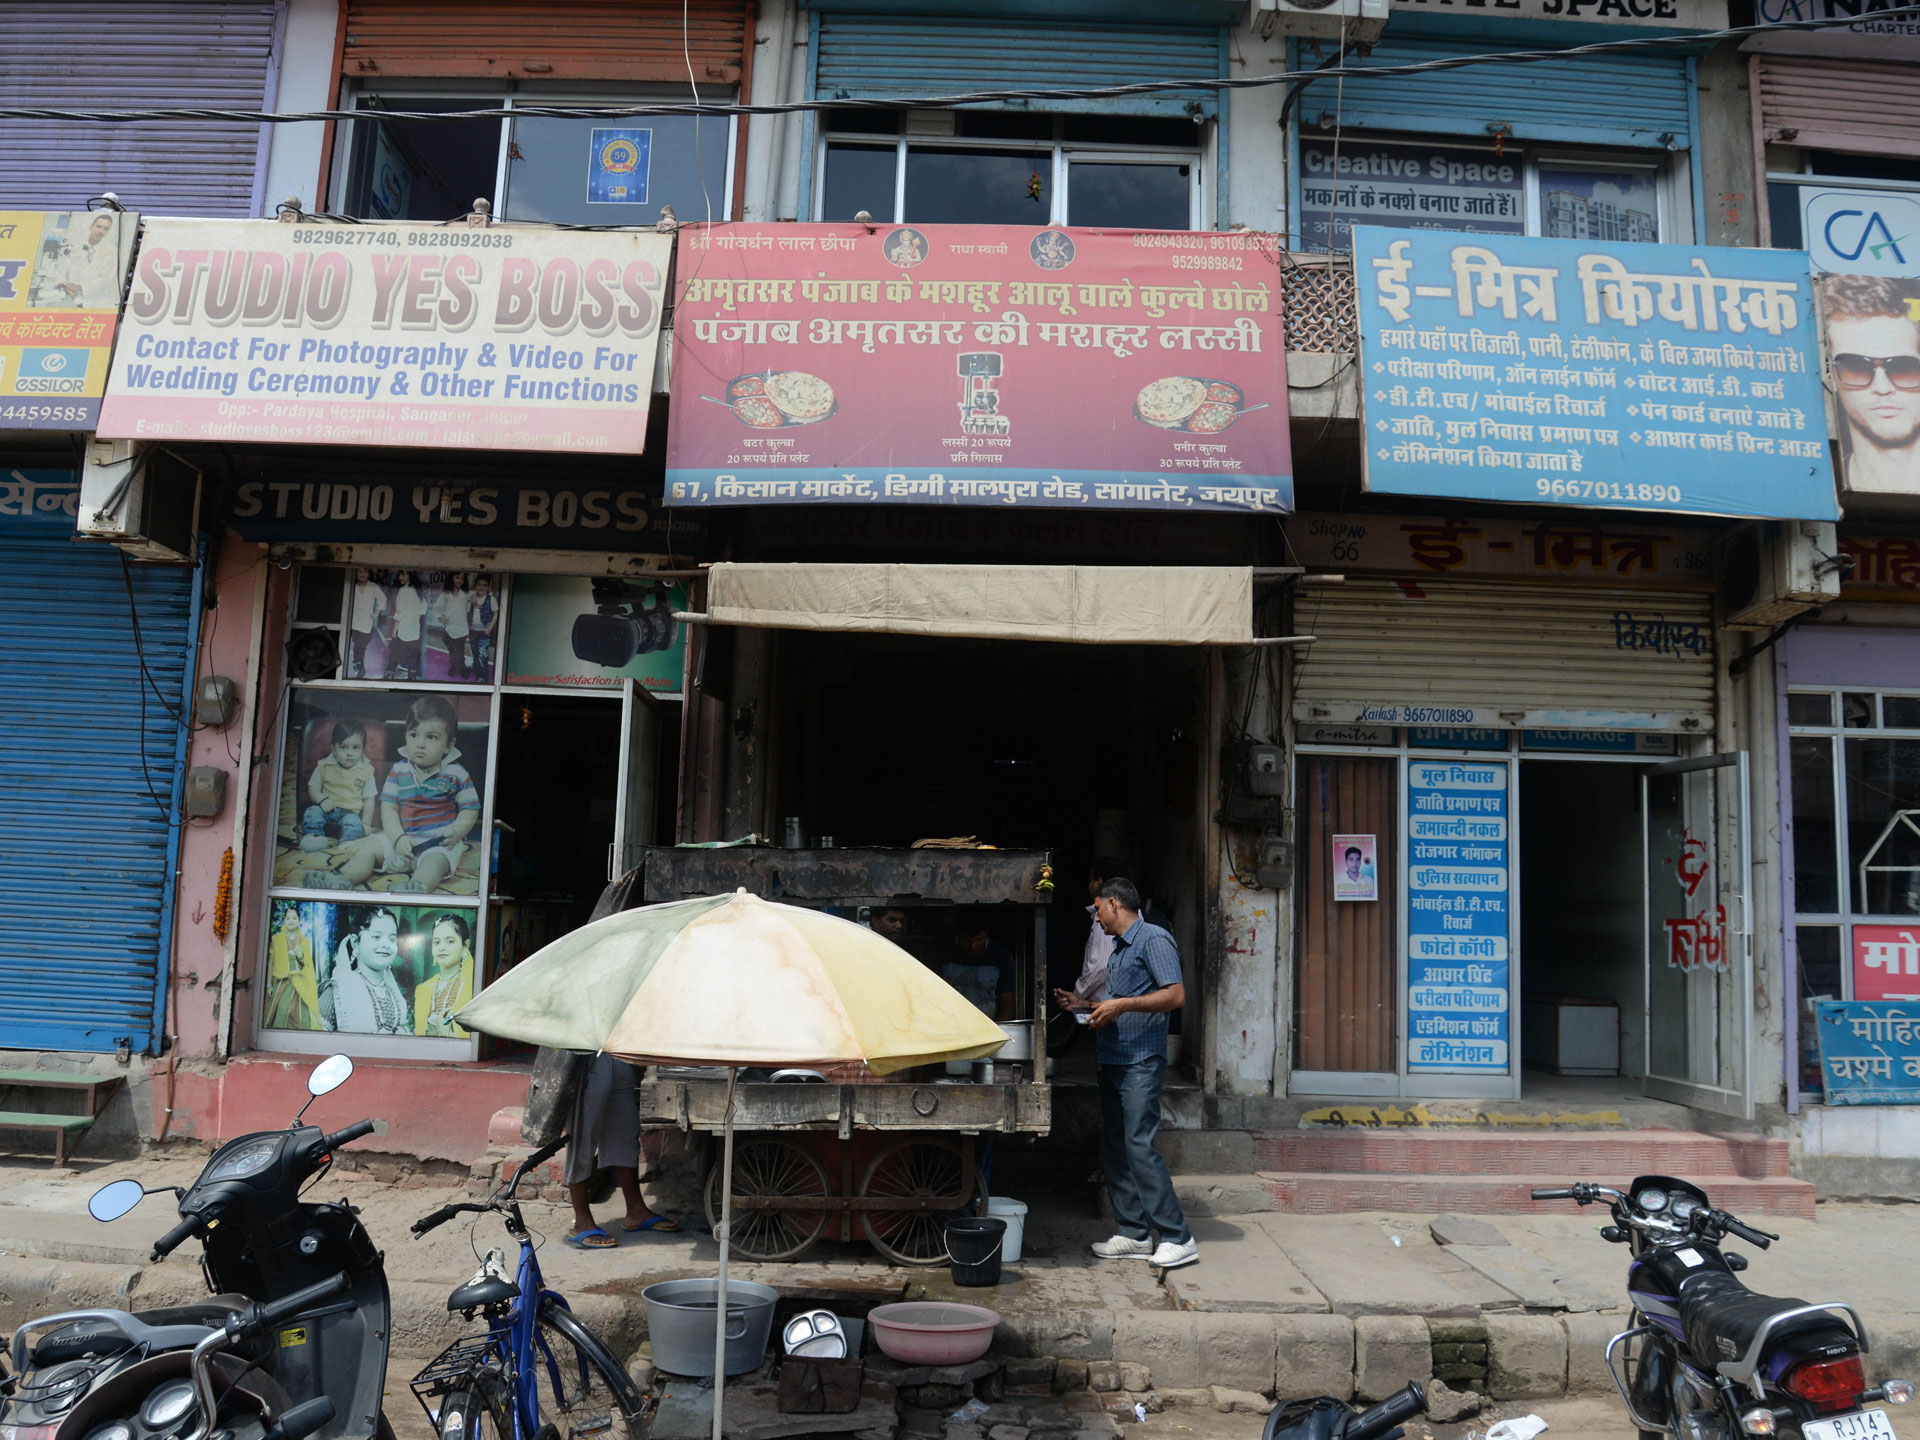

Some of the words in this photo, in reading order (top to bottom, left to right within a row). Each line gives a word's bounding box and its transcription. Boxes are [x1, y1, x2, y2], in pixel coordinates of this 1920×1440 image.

[1305, 150, 1421, 178] Creative
[1429, 156, 1514, 184] Space
[1304, 184, 1357, 208] मकानों
[1360, 186, 1375, 208] के
[1379, 188, 1416, 211] नक्शे
[1419, 194, 1460, 213] बनाए
[1463, 193, 1496, 215] जाते
[292, 230, 402, 248] 9829627740,
[407, 232, 513, 248] 9828092038
[715, 232, 774, 251] गोवर्धन
[778, 236, 815, 251] लाल
[819, 233, 857, 251] छीपा
[1824, 210, 1906, 264] CA
[950, 243, 975, 255] राधा
[977, 241, 1008, 256] स्वामी
[132, 247, 352, 330] STUDIO
[371, 253, 482, 334] YES
[493, 256, 662, 340] BOSS
[685, 278, 796, 311] अमृतसर
[801, 271, 882, 304] पंजाब
[885, 273, 914, 304] के
[919, 279, 1002, 313] मशहूर
[1008, 281, 1077, 316] आलू
[1078, 278, 1134, 308] वाले
[1139, 280, 1204, 318] कुल्चे
[1211, 282, 1271, 313] छोले
[1372, 240, 1559, 323] ई-मित्र
[1577, 253, 1799, 336] कियोस्क
[692, 311, 801, 345] पंजाब
[808, 318, 966, 353] अमृतसर
[972, 311, 1031, 347] की
[1036, 321, 1151, 358] मशहूर
[1156, 317, 1263, 353] लस्सी
[136, 333, 239, 361] Contact
[248, 337, 290, 361] For
[298, 338, 469, 371] Photography
[477, 342, 497, 367] &
[509, 344, 584, 369] Video
[594, 347, 637, 372] For
[1379, 324, 1416, 350] हमारे
[1418, 325, 1447, 351] यहाँ
[1448, 333, 1468, 352] पर
[1470, 329, 1527, 360] बिजली,
[1528, 330, 1568, 362] पानी,
[1639, 338, 1654, 362] के
[1658, 339, 1688, 366] बिल
[1690, 347, 1722, 368] जमा
[1723, 343, 1755, 371] किये
[1757, 346, 1787, 373] जाते
[127, 364, 239, 396] Wedding
[247, 367, 381, 400] Ceremony
[389, 370, 409, 396] &
[420, 371, 495, 398] Other
[504, 374, 639, 403] Functions
[1387, 356, 1434, 380] परीक्षा
[1437, 359, 1502, 386] परिणाम,
[1505, 362, 1538, 386] ऑन
[1540, 365, 1581, 389] लाईन
[1583, 366, 1616, 390] फॉर्म
[1638, 367, 1678, 393] वोटर
[1750, 378, 1785, 400] कार्ड
[263, 403, 325, 420] Pardaya
[1484, 389, 1551, 416] मोबाईल
[1555, 394, 1605, 417] रिचार्ज
[1641, 398, 1668, 421] पेन
[1672, 401, 1705, 423] कार्ड
[1757, 407, 1792, 430] जाते
[1792, 407, 1806, 431] है
[1391, 415, 1441, 441] जाति,
[1444, 420, 1477, 445] मुल
[1479, 417, 1533, 442] निवास
[1539, 426, 1592, 447] प्रमाण
[1594, 428, 1619, 447] पत्र
[743, 439, 764, 448] बटर
[942, 436, 968, 448] लस्सी
[971, 438, 984, 447] 20
[1173, 442, 1196, 454] पनीर
[1645, 429, 1697, 449] आधार
[1700, 430, 1734, 452] कार्ड
[1736, 431, 1775, 455] प्रिन्ट
[1779, 437, 1823, 459] आउट
[727, 455, 740, 464] 20
[769, 452, 787, 465] प्रति
[789, 452, 810, 465] प्लेट
[950, 451, 968, 465] प्रति
[970, 450, 1003, 464] गिलास
[1160, 459, 1173, 468] 30
[1202, 458, 1219, 470] प्रति
[1221, 458, 1242, 470] प्लेट
[1393, 441, 1474, 468] लेमिनेशन
[1478, 445, 1522, 470] किया
[1526, 452, 1568, 473] जाता
[1569, 448, 1583, 473] है
[672, 481, 708, 503] 67,
[714, 474, 798, 498] किसान
[801, 474, 878, 500] मार्केट,
[884, 474, 946, 497] डिग्गी
[949, 479, 1038, 504] मालपुरा
[1042, 475, 1088, 503] रोड,
[1095, 479, 1194, 507] सांगानेर,
[1199, 485, 1279, 510] जयपुर
[1536, 478, 1682, 503] 9667011890
[233, 482, 394, 522] STUDIO
[411, 486, 499, 525] YES
[516, 489, 649, 532] BOSS
[1332, 540, 1360, 561] 66
[555, 674, 612, 687] Satisfaction
[643, 677, 674, 688] Motto
[1421, 769, 1447, 786] मूल
[1450, 767, 1495, 783] निवास
[1415, 793, 1444, 811] जाति
[1446, 798, 1481, 812] प्रमाण
[1483, 798, 1501, 811] पत्र
[1416, 819, 1466, 837] जमाबन्दी
[1468, 823, 1501, 837] नकल
[1414, 842, 1459, 858] रोजगार
[1416, 869, 1450, 886] पुलिस
[1453, 872, 1499, 885] सत्यापन
[1412, 895, 1452, 912] मोबाईल
[1443, 914, 1473, 930] रिचार्ज
[1420, 936, 1457, 956] फोटो
[1459, 937, 1496, 956] कॉपी
[1424, 967, 1465, 982] आधार
[1467, 964, 1492, 983] प्रिंट
[1415, 988, 1452, 1007] परीक्षा
[1454, 989, 1501, 1008] परिणाम
[1471, 1016, 1499, 1035] फॉर्म
[1420, 1040, 1494, 1062] लेमिनेशन
[1828, 1043, 1894, 1083] चश्मे
[1826, 1346, 1848, 1356] Hero
[1832, 1413, 1878, 1438] RJ14
